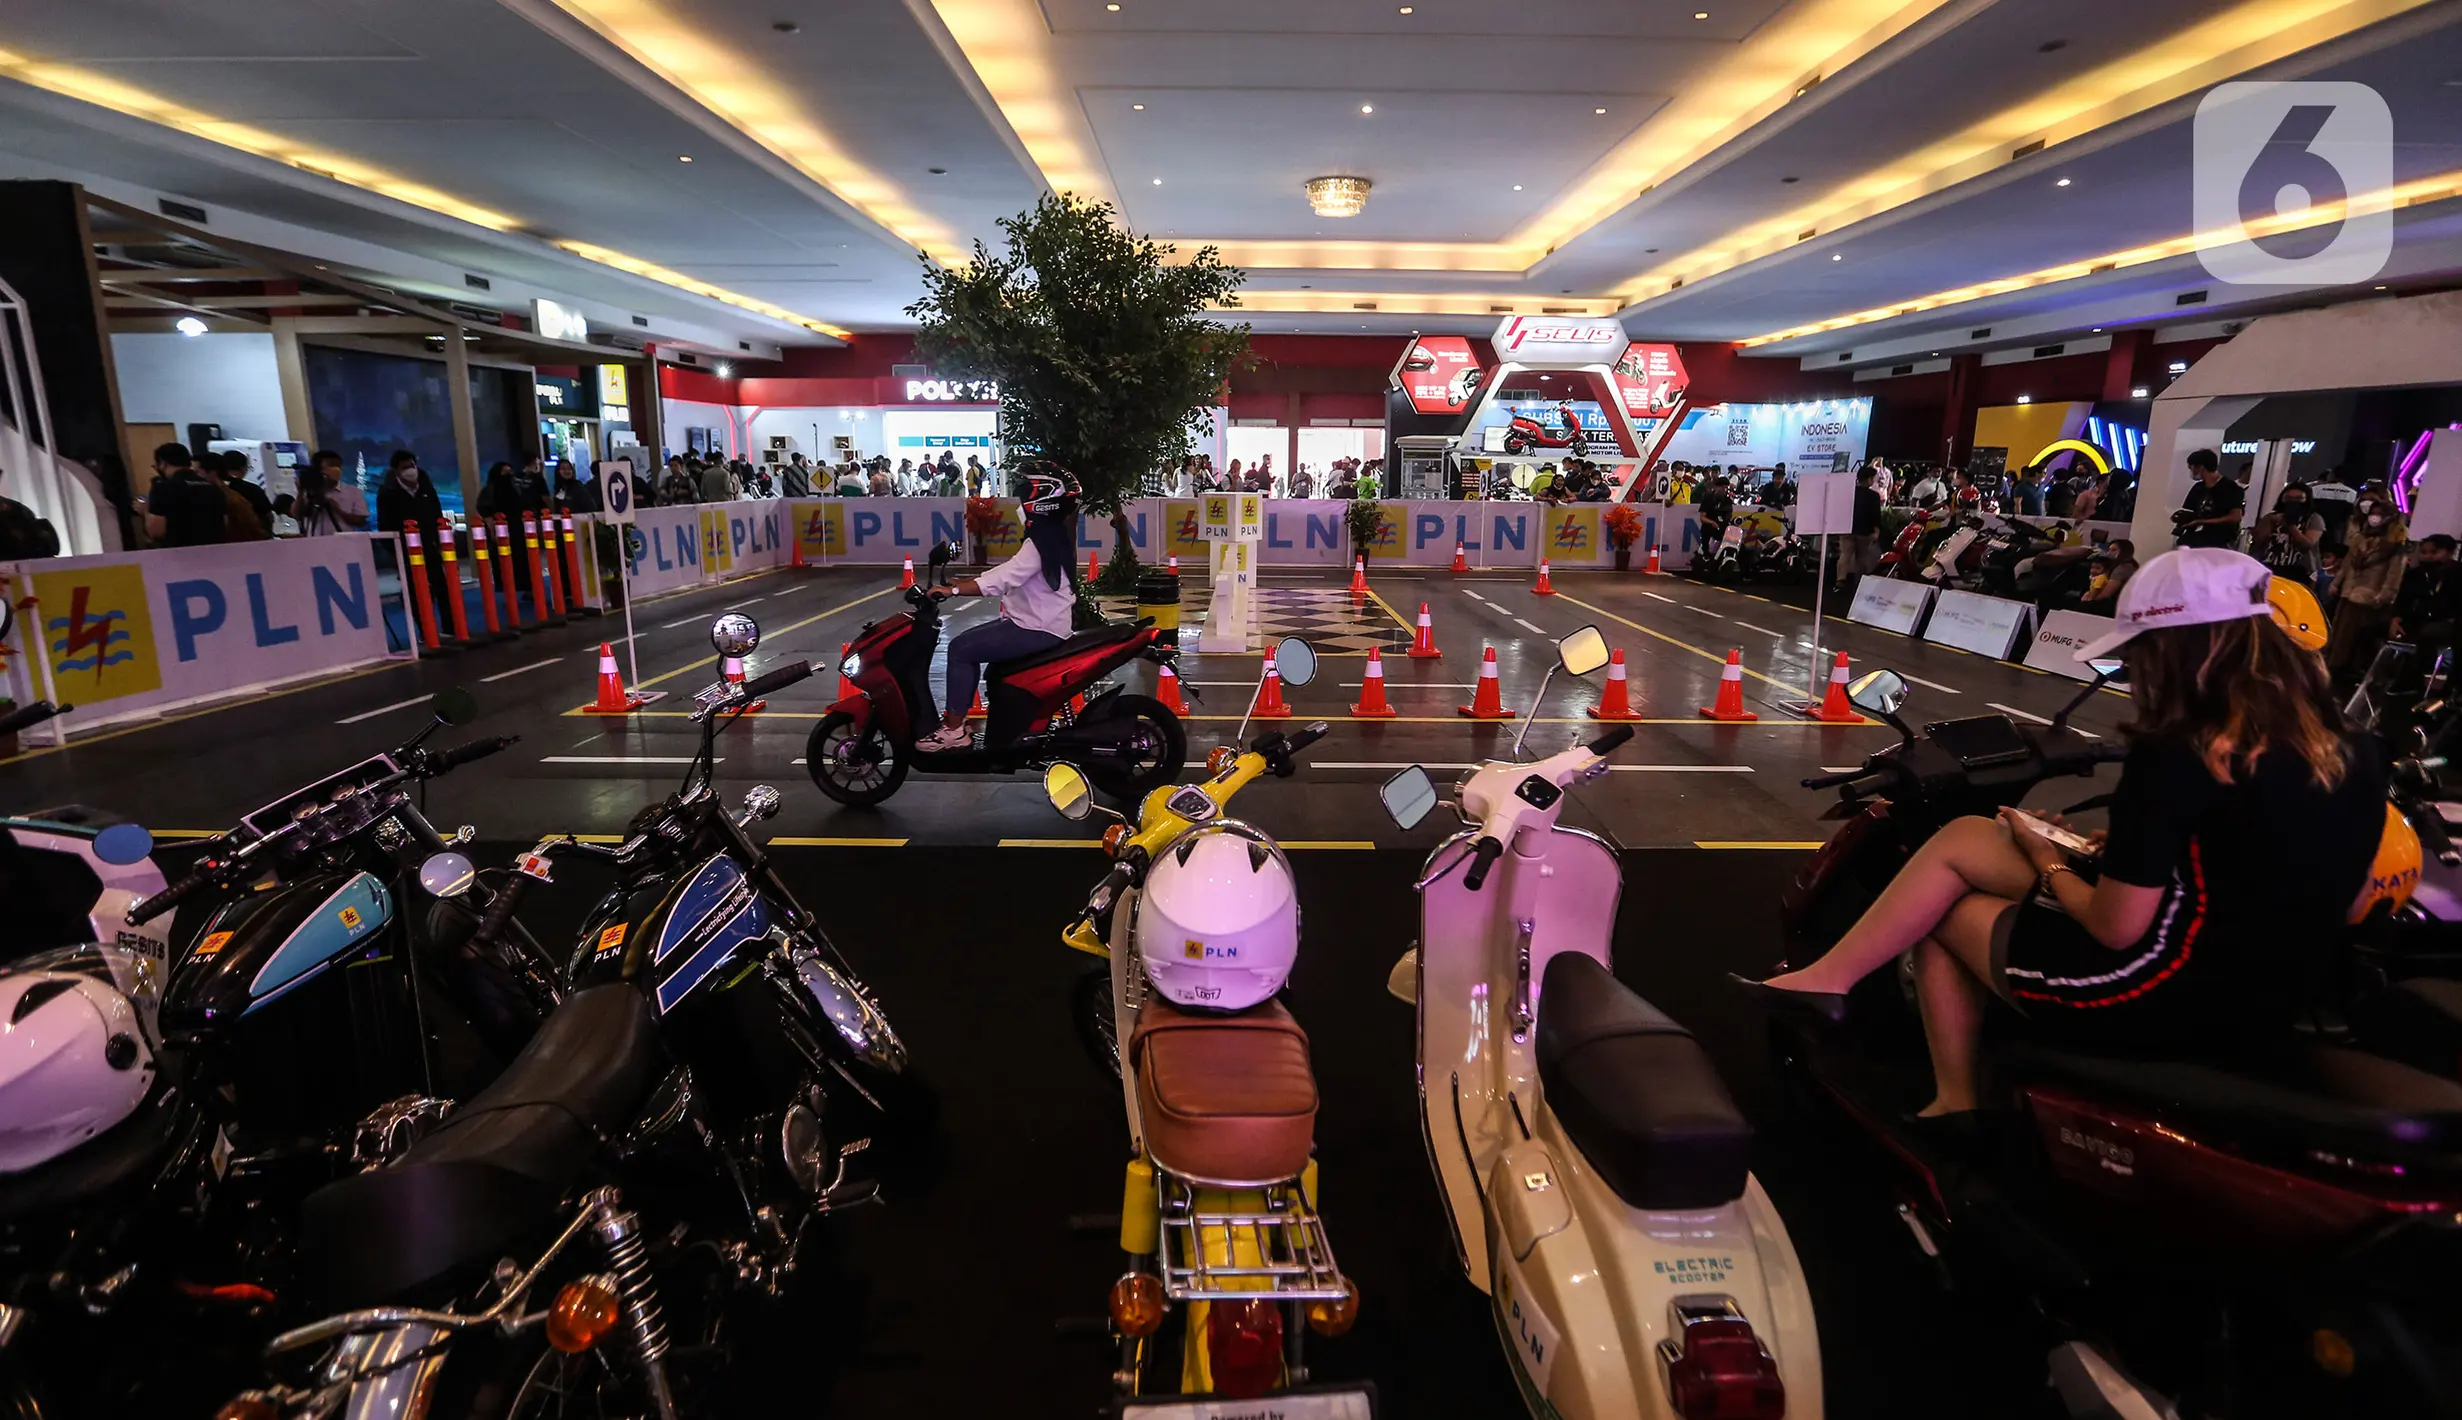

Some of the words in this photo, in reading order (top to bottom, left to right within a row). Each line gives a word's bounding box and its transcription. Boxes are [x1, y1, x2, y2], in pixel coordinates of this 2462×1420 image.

[1532, 328, 1616, 340] SELIS
[1801, 422, 1847, 436] INDONESIA
[1817, 443, 1836, 451] STORE
[2221, 440, 2258, 453] uture
[2290, 441, 2316, 453] ow
[1036, 503, 1059, 511] GESITS
[731, 513, 780, 557] PLN
[853, 511, 963, 547] PLN
[1077, 513, 1147, 548] LN
[1206, 527, 1228, 537] PLN
[1241, 526, 1257, 535] PLN
[1268, 513, 1338, 549] LN
[1416, 514, 1525, 550] PLN
[631, 523, 697, 576] PLN
[166, 562, 370, 662] PLN
[2051, 634, 2074, 646] MUFG
[349, 924, 366, 936] PLN
[593, 946, 621, 963] PLN
[1206, 947, 1237, 957] PLN
[186, 954, 216, 965] PLN
[1200, 990, 1216, 1000] DOT
[1654, 1257, 1734, 1274] ELECTRIC
[1669, 1272, 1726, 1284] SCOOTER
[1512, 1299, 1545, 1365] PLN
